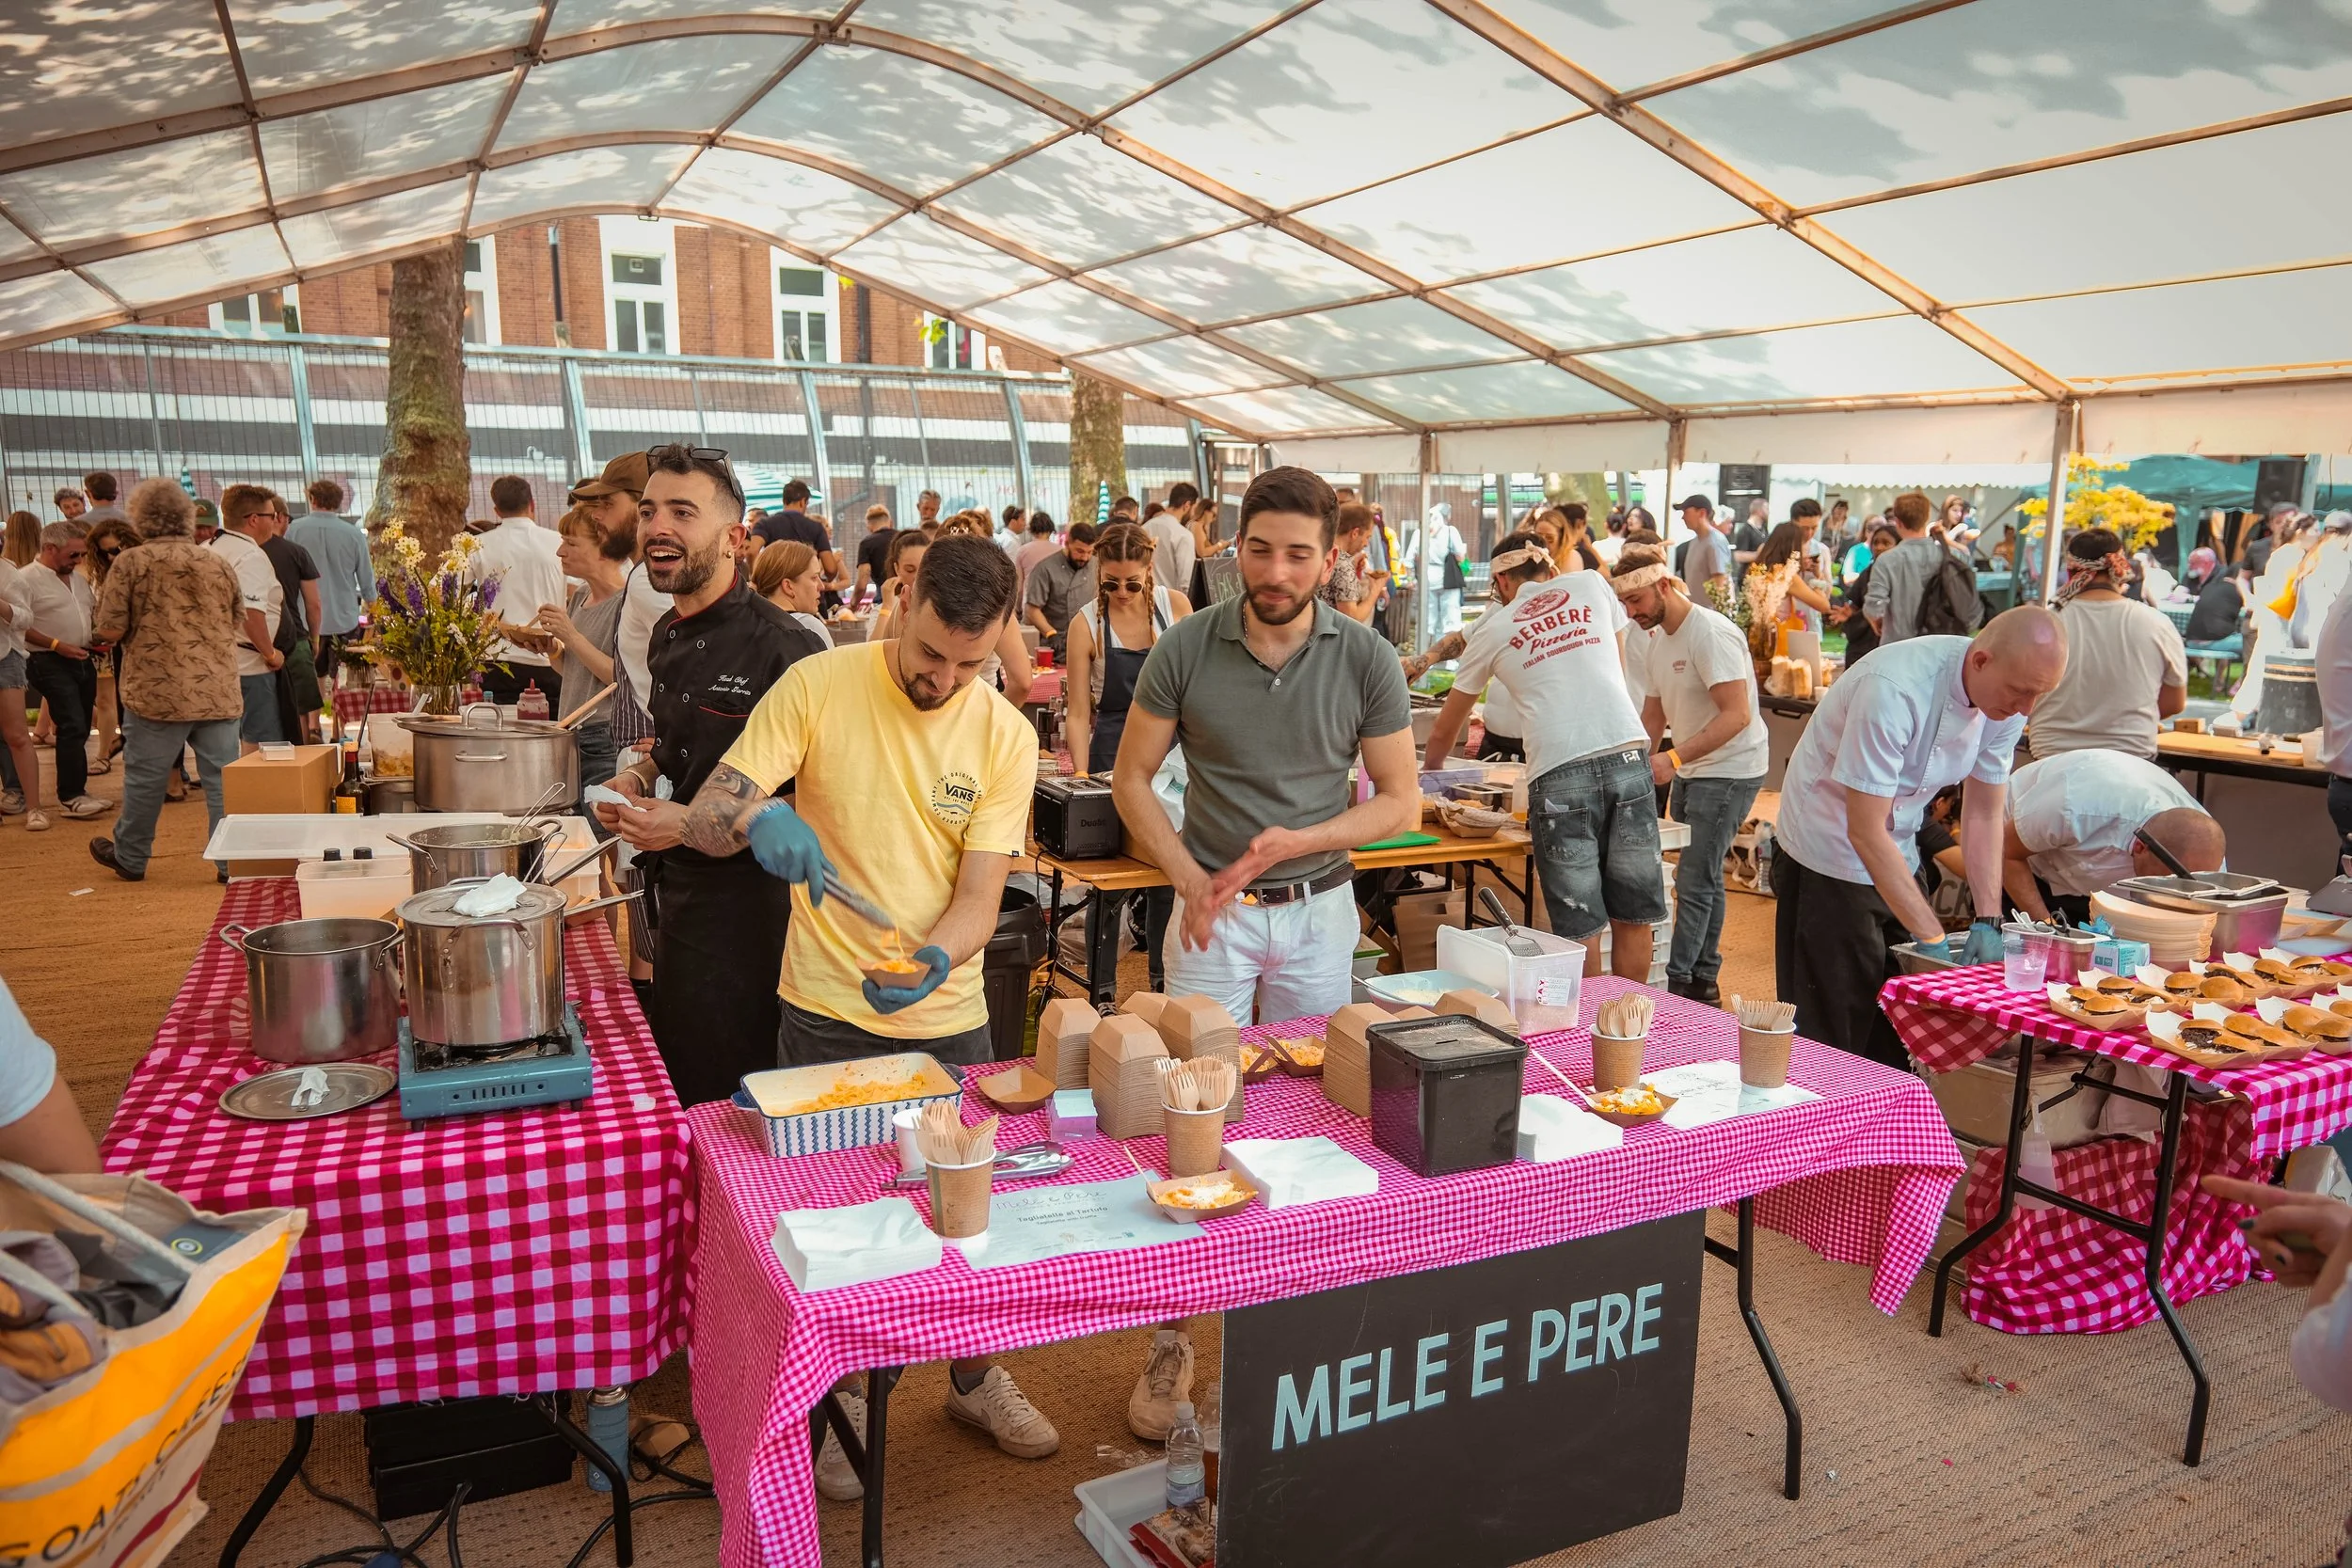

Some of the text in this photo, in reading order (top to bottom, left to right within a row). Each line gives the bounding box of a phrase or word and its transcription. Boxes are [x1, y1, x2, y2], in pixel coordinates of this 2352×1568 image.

[1509, 605, 1592, 650] BERBERÈ
[1529, 626, 1588, 655] Pizzeria
[1522, 637, 1601, 670] ITALIAN SOURDOUGH PIZZA
[946, 783, 976, 802] VANS
[1272, 1282, 1662, 1451] MELE E PERE
